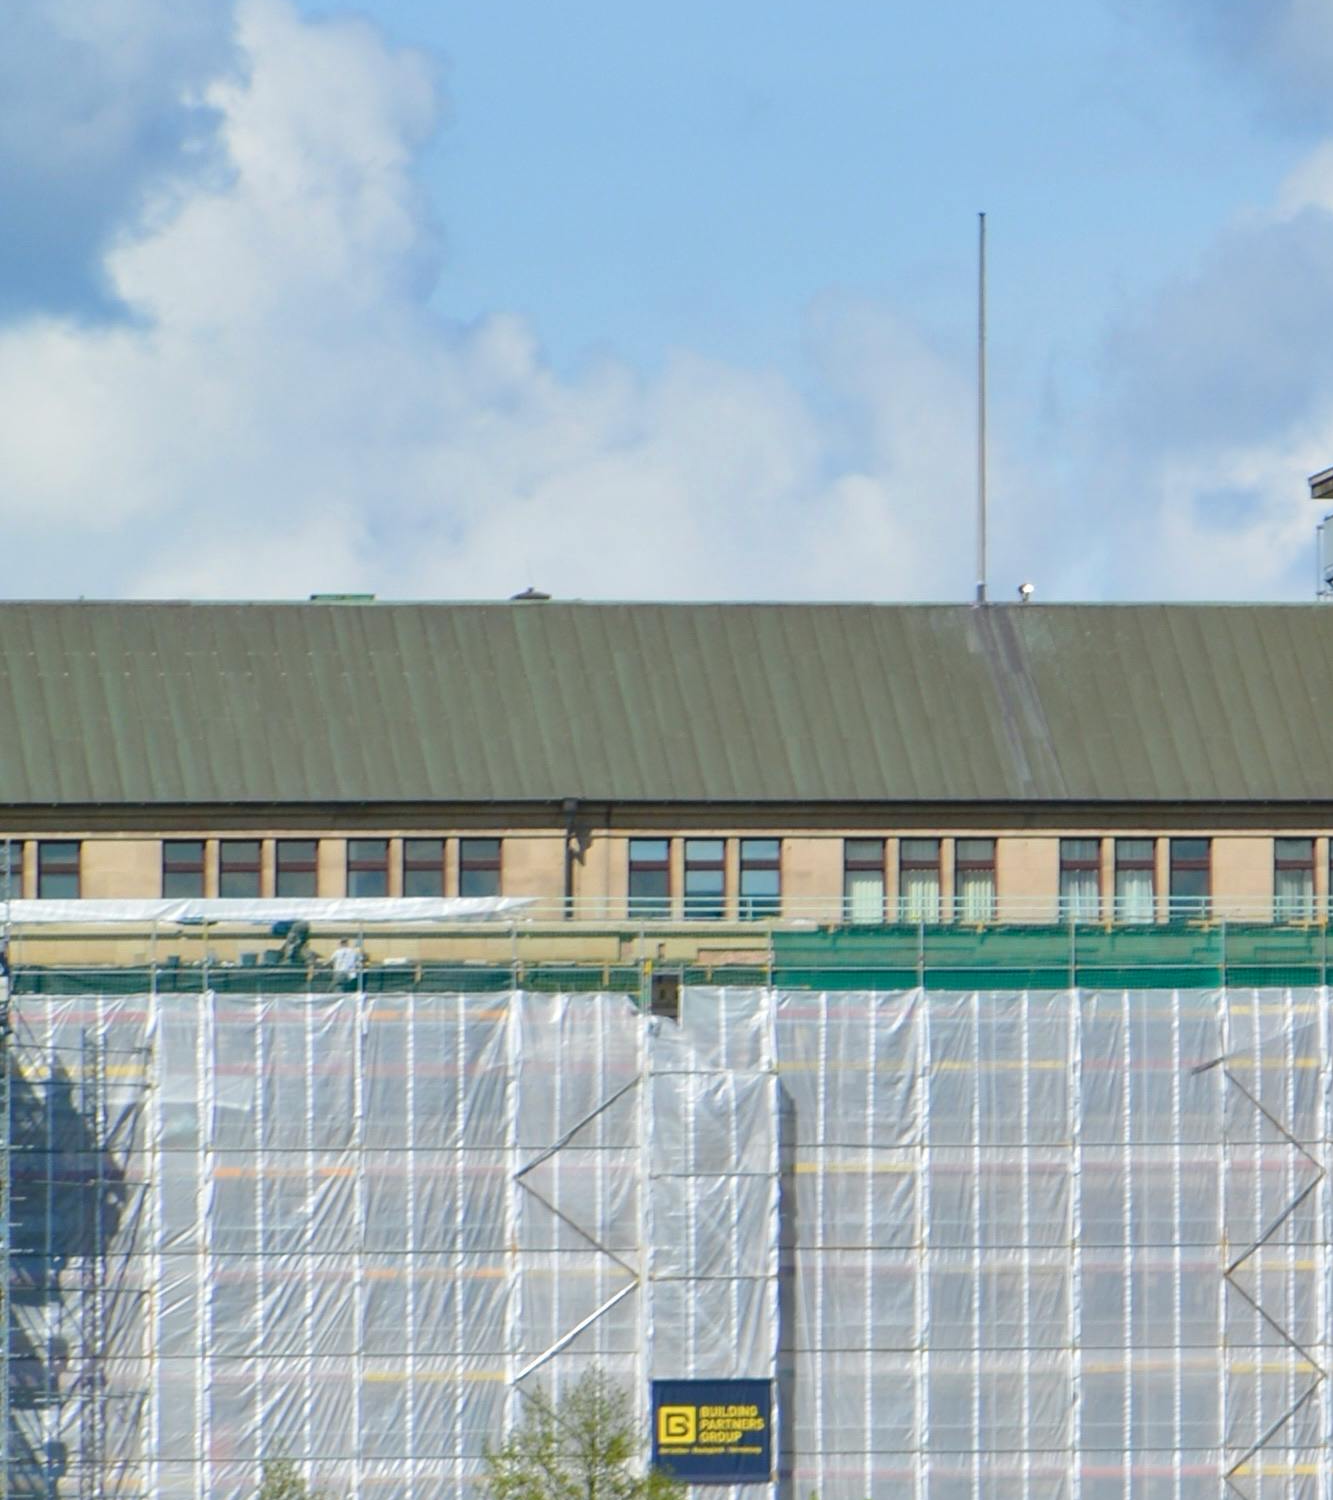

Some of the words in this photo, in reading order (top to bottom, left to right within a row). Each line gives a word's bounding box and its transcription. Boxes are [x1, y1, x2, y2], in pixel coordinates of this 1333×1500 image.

[699, 1405, 758, 1417] BUILDING
[699, 1418, 765, 1431] PARTNERS
[699, 1431, 743, 1443] GROUP
